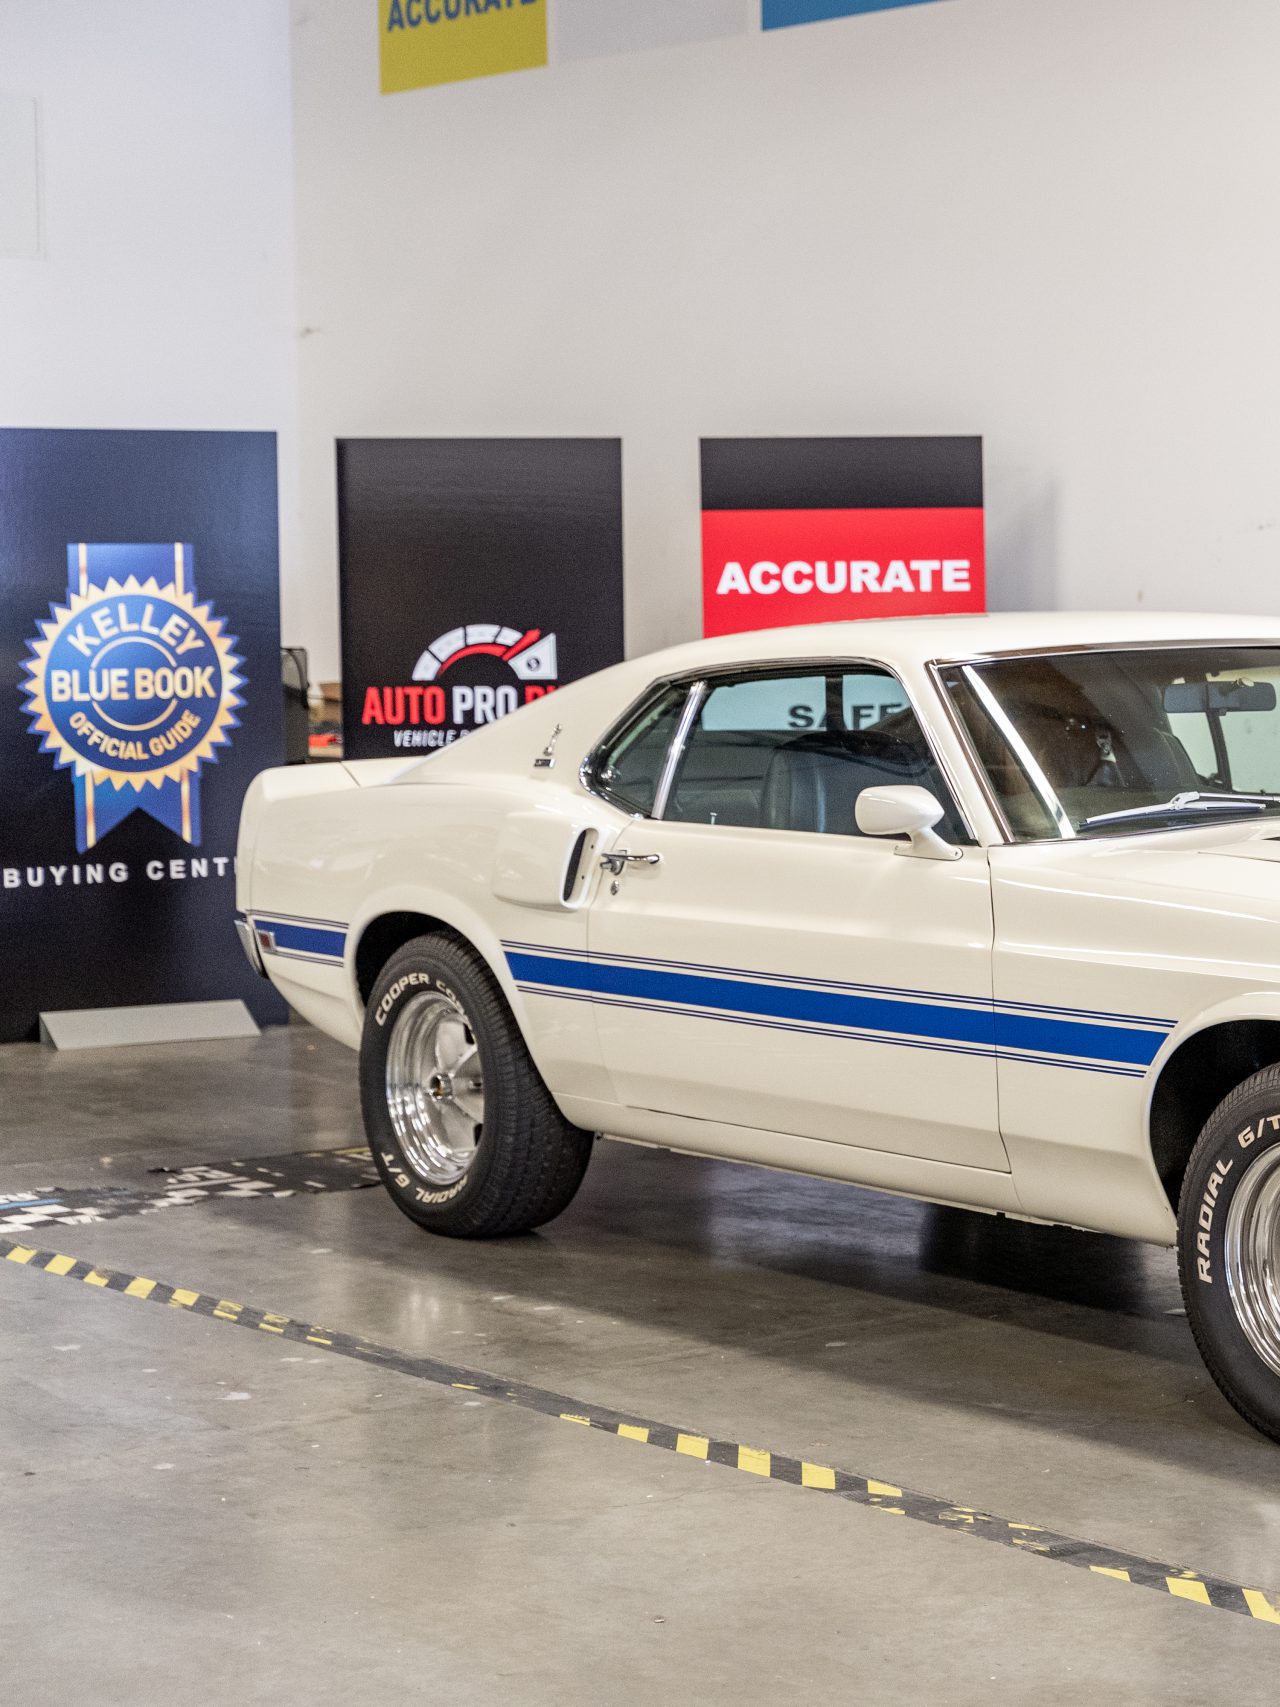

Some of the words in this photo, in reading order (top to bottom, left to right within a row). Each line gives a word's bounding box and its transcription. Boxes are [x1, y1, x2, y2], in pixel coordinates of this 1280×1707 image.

[386, 0, 537, 32] ACCU
[716, 559, 971, 594] ACCURATE
[66, 602, 205, 657] KELLEY
[51, 668, 129, 702] BLUE
[135, 666, 216, 700] BOOK
[361, 686, 445, 725] AUTO
[452, 685, 518, 724] PRO
[788, 703, 902, 731] SF
[69, 711, 149, 760] OFFICIAL
[149, 709, 201, 757] GUIDE
[393, 730, 456, 748] VEHICLE
[3, 862, 129, 888] BUYING
[146, 856, 237, 881] CENT
[375, 972, 430, 1027] COOPER
[381, 1152, 410, 1188] G/T
[1196, 1159, 1234, 1284] RADIAL
